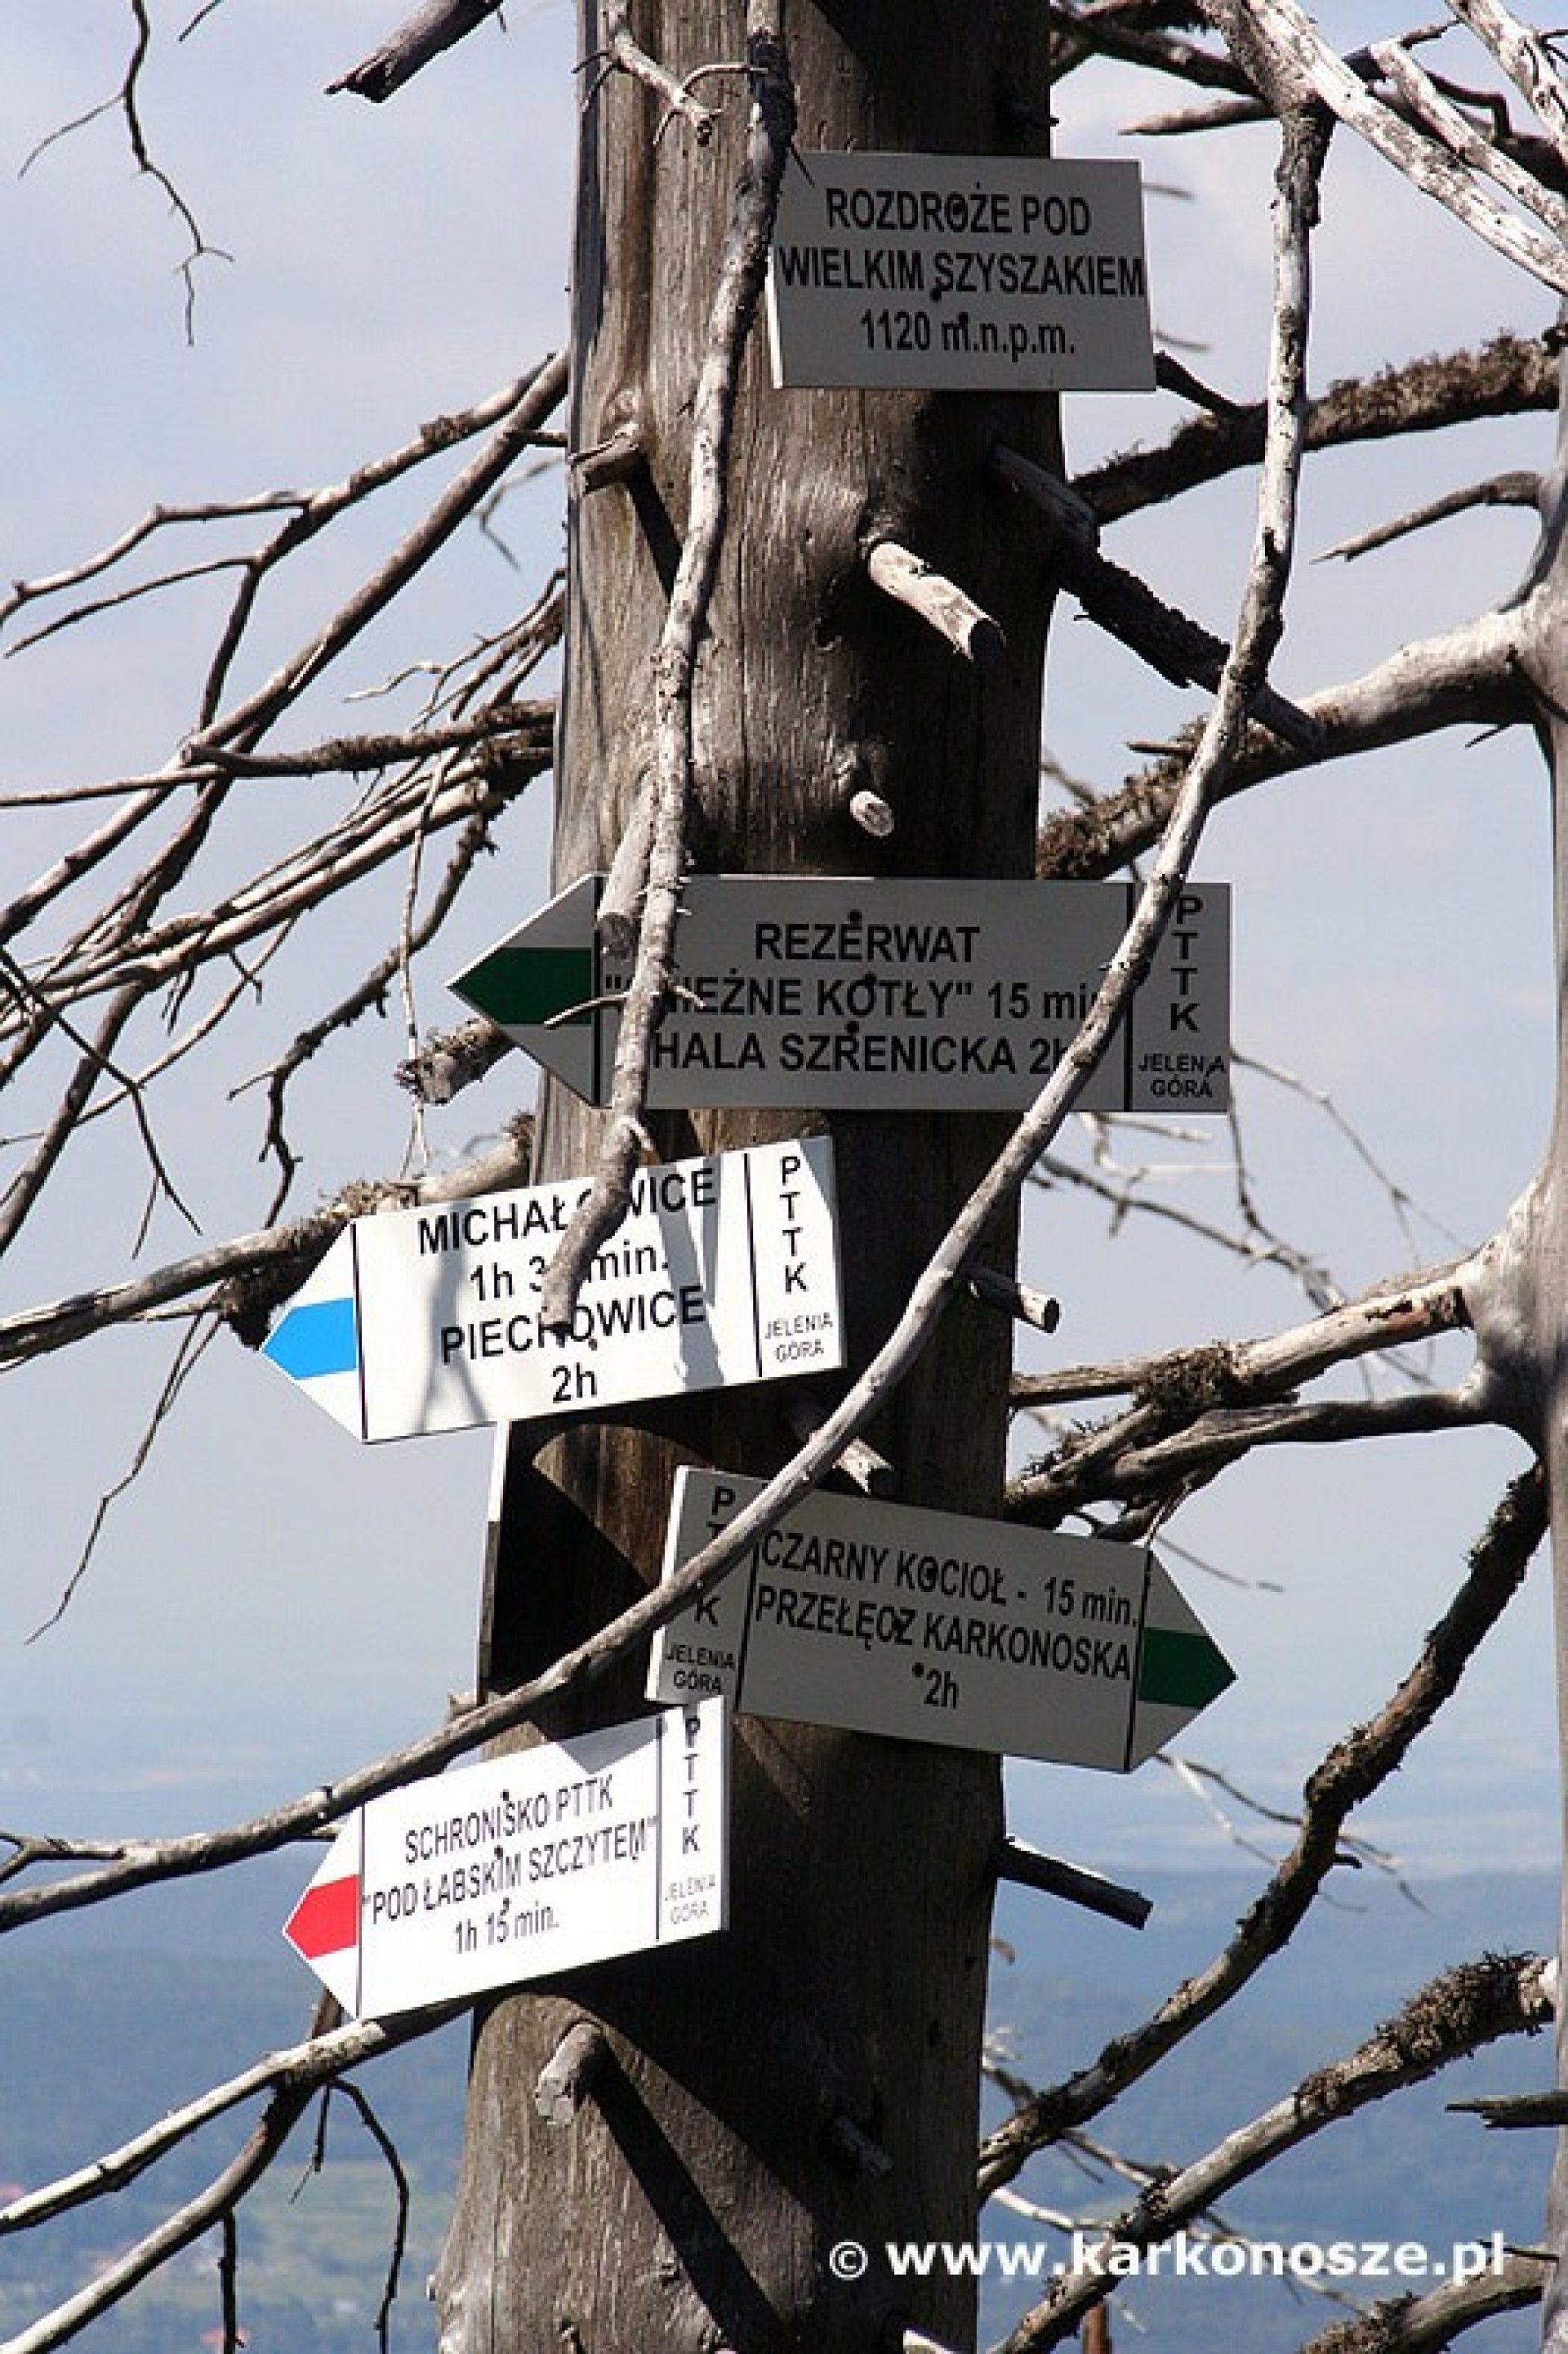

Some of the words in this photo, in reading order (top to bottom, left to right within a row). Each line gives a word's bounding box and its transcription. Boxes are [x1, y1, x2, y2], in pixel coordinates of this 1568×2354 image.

[826, 182, 1011, 233] ROZDROŻE
[1023, 196, 1090, 235] POD
[780, 247, 924, 289] WIELKIM
[934, 252, 1144, 296] SZYSZAKIEM
[861, 309, 930, 350] 1120
[942, 320, 1075, 363] m.n.p.m.
[755, 923, 980, 962] REZERWAT
[818, 979, 972, 1019] KOTŁY"
[987, 982, 1031, 1019] 15
[1044, 982, 1099, 1019] mi
[655, 1033, 766, 1069] HALA
[779, 1034, 1016, 1074] SZRENICKA
[470, 1262, 514, 1301] 1h
[552, 1362, 597, 1403] 2h
[761, 1529, 889, 1584] CZARNY
[896, 1551, 1007, 1607] KOCIOŁ
[1044, 1576, 1074, 1616] 15
[1082, 1586, 1138, 1628] min.
[756, 1585, 917, 1651] PRZEŁĘCZ
[923, 1612, 1131, 1681] KARKONOSKA
[924, 1669, 959, 1710] 2h
[405, 1791, 550, 1864] SCHRONISKO
[555, 1773, 613, 1822] PTTK
[455, 1918, 478, 1955] 1h
[487, 1910, 510, 1946] 15
[514, 1900, 559, 1940] min.
